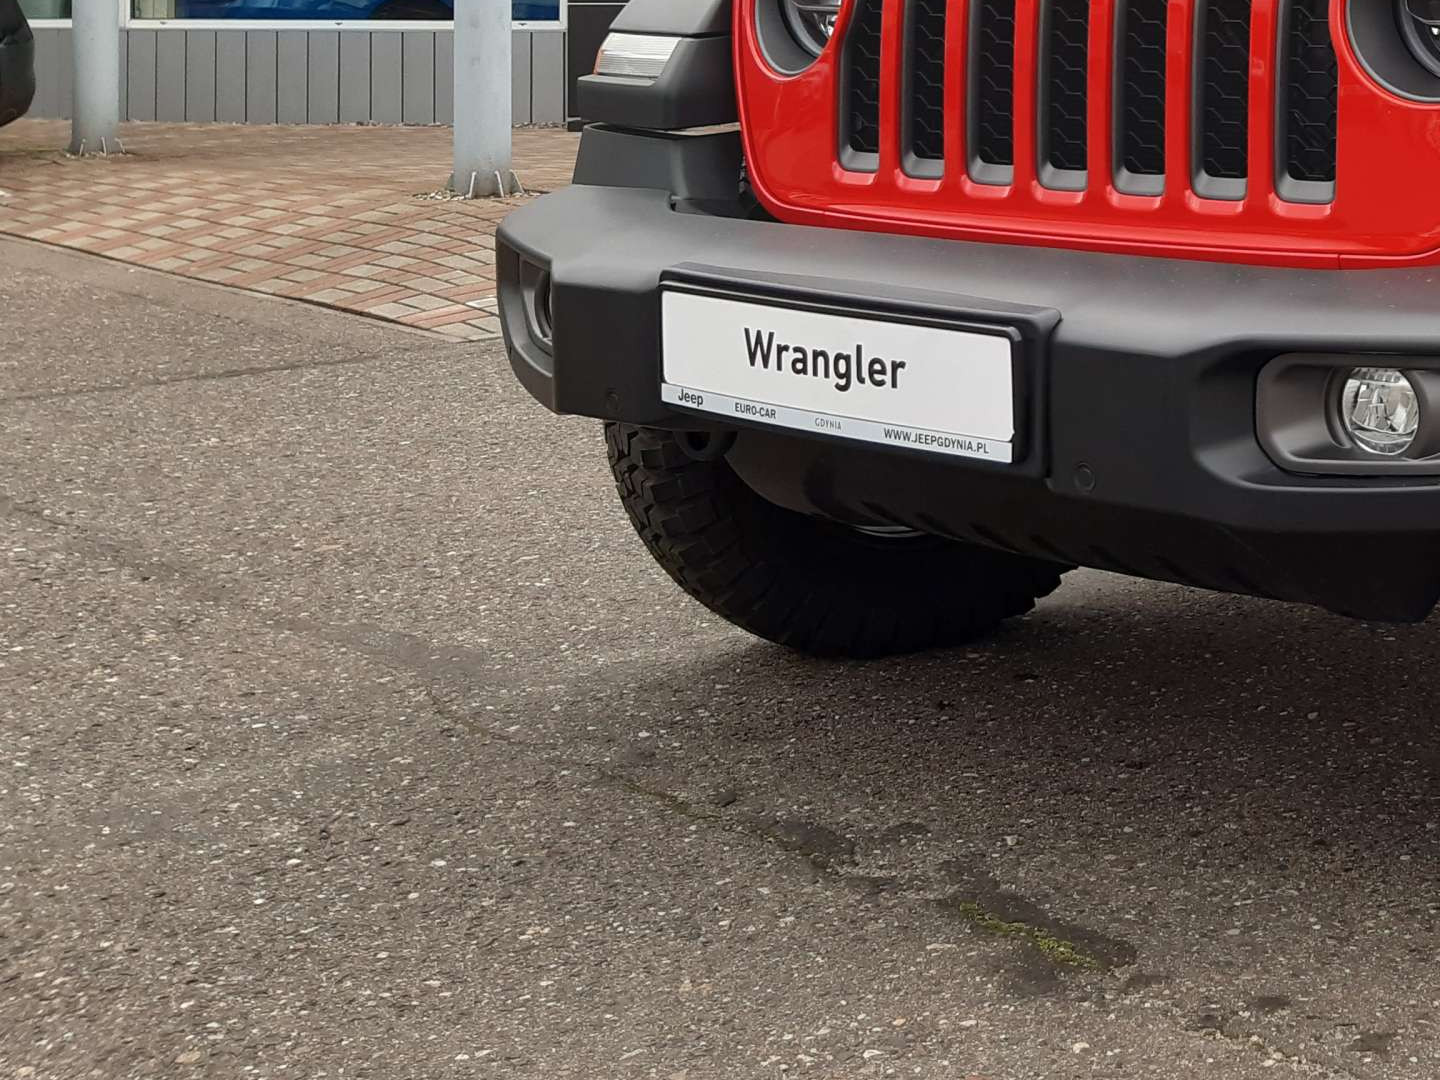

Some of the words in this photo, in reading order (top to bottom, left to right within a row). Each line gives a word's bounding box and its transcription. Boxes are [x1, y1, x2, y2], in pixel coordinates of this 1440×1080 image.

[743, 327, 906, 392] Wrangler
[678, 389, 704, 407] Jeep
[734, 402, 777, 420] EURO-CAR
[814, 417, 842, 431] GDYNIA
[883, 427, 989, 454] WWW.JEEPGDYNIA.PL
